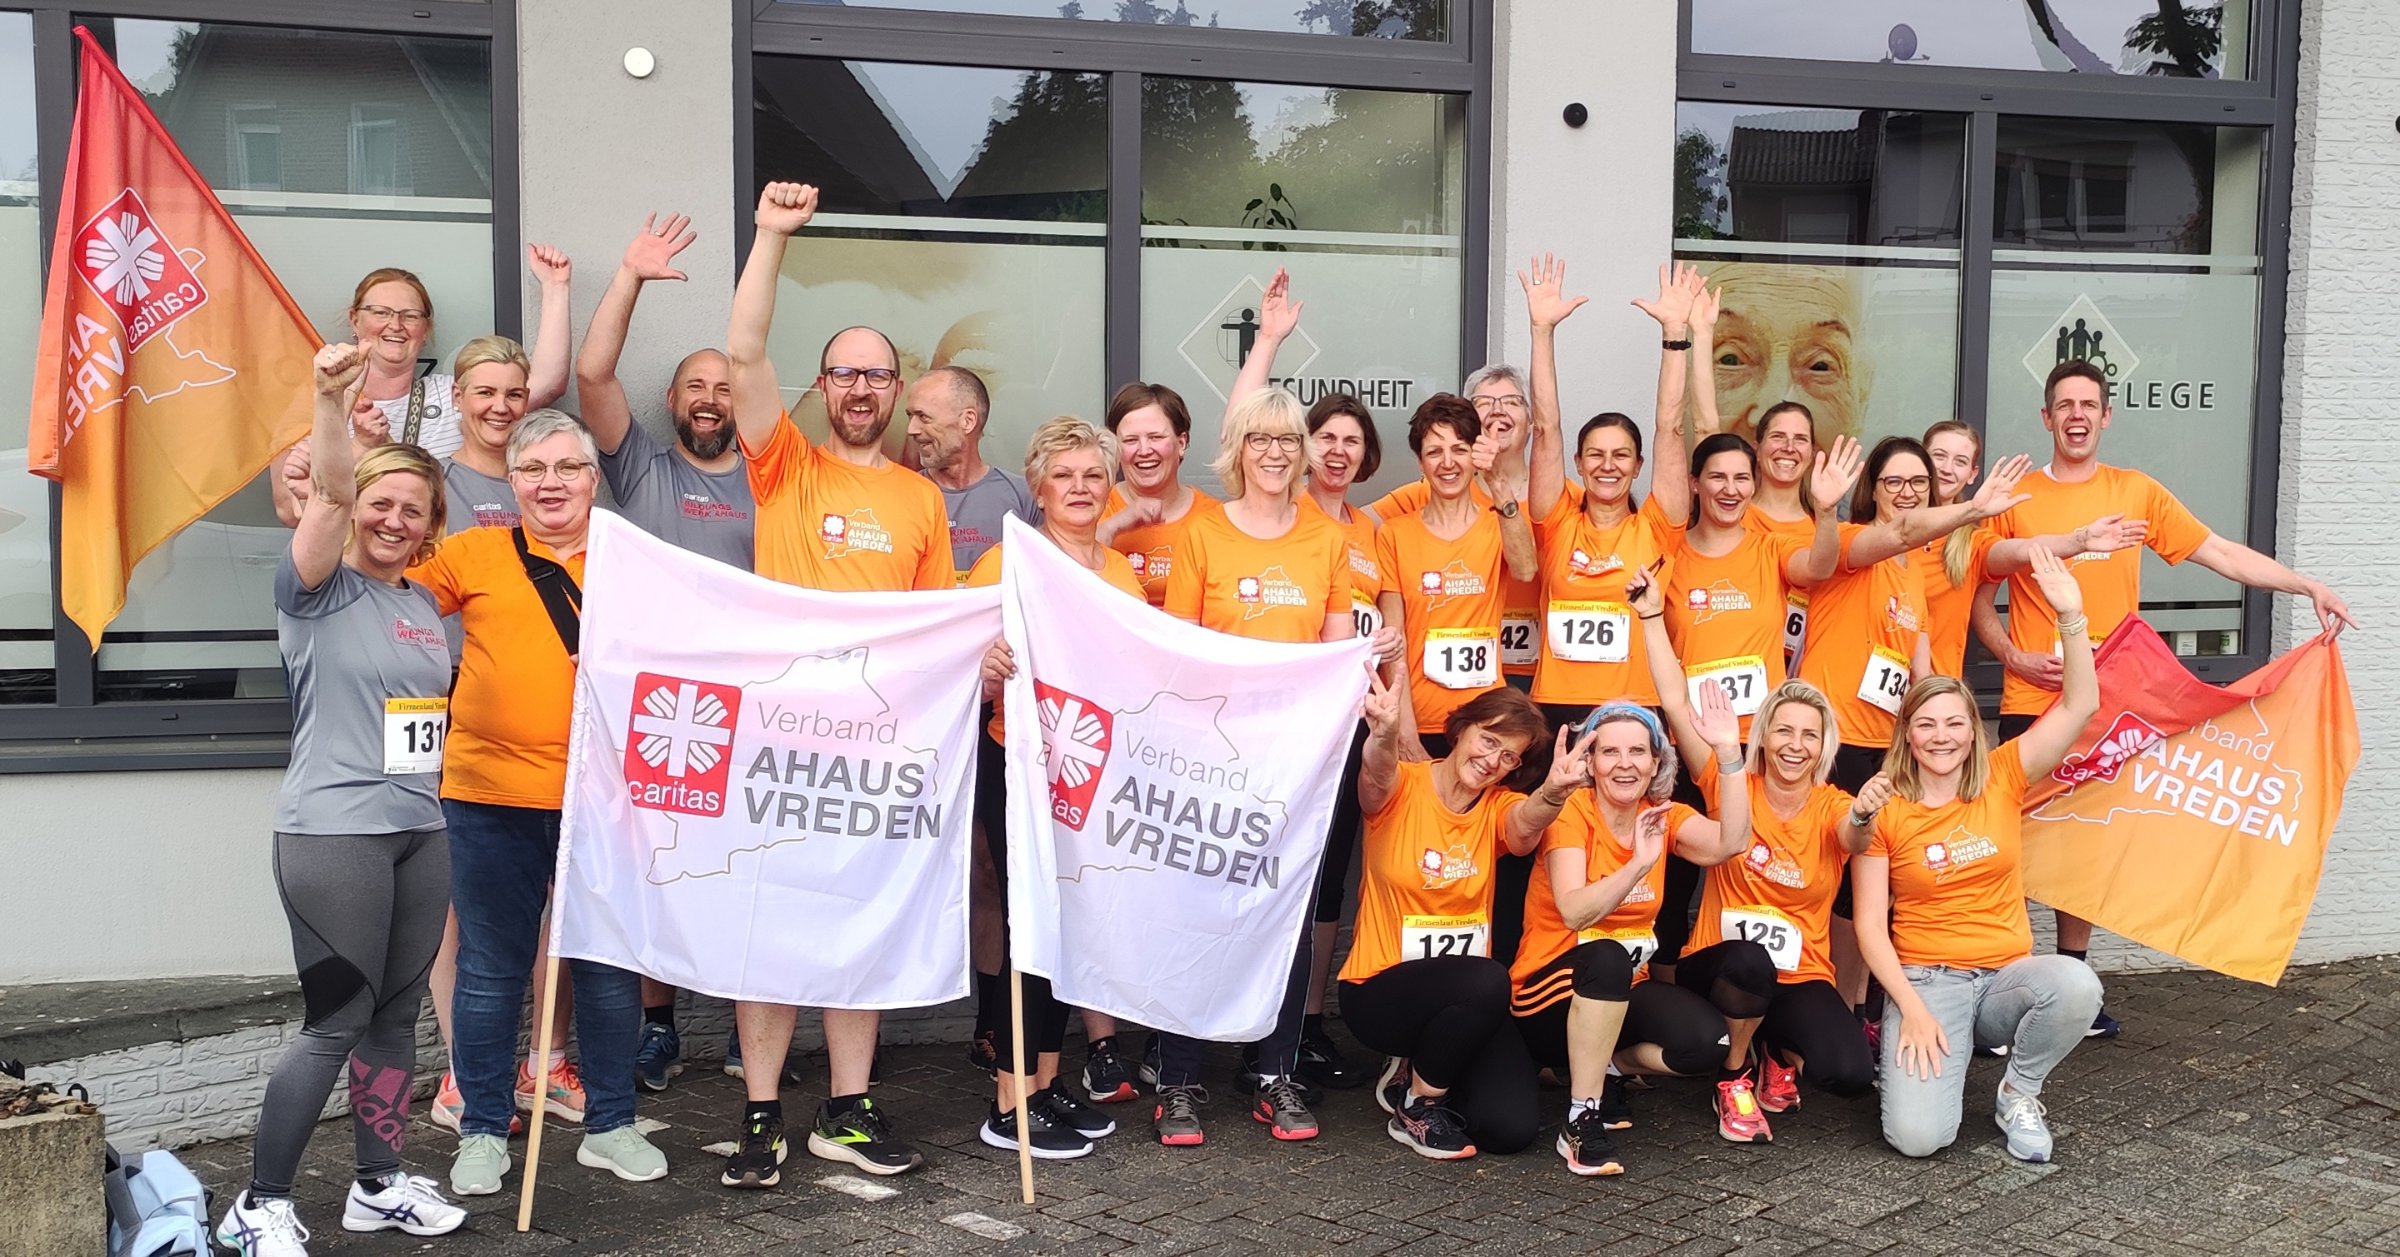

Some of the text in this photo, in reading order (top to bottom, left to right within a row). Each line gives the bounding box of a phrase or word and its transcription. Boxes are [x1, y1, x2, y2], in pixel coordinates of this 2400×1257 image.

[2106, 382, 2214, 409] FLEGE
[848, 529, 888, 542] AHAUS
[848, 537, 893, 554] VREDEN
[1149, 561, 1171, 570] AHA
[1263, 586, 1300, 597] AHAUS
[1445, 578, 1479, 588] AHAUS
[1445, 585, 1486, 595] VREDEN
[1263, 595, 1307, 606] VREDEN
[1711, 594, 1745, 603] AHAUS
[1711, 600, 1752, 610] VREDEN
[1500, 625, 1530, 650] 42
[1562, 618, 1614, 646] 126
[1441, 646, 1487, 672] 138
[1721, 674, 1753, 701] 37
[404, 720, 443, 753] 131
[757, 700, 899, 746] Verband
[744, 746, 924, 799] AHAUS
[1126, 729, 1249, 793] Verband
[2138, 736, 2286, 806] AHAUS
[626, 779, 721, 813] caritas
[2133, 762, 2300, 847] VREDEN
[743, 786, 942, 840] VREDEN
[1110, 775, 1272, 848] AHAUS
[1105, 809, 1281, 891] VREDEN
[1951, 840, 1989, 857] AHAUS
[1951, 845, 1999, 864] VREDEN
[1624, 891, 1656, 904] REDEN
[1419, 932, 1474, 959] 127
[1735, 920, 1787, 952] 125
